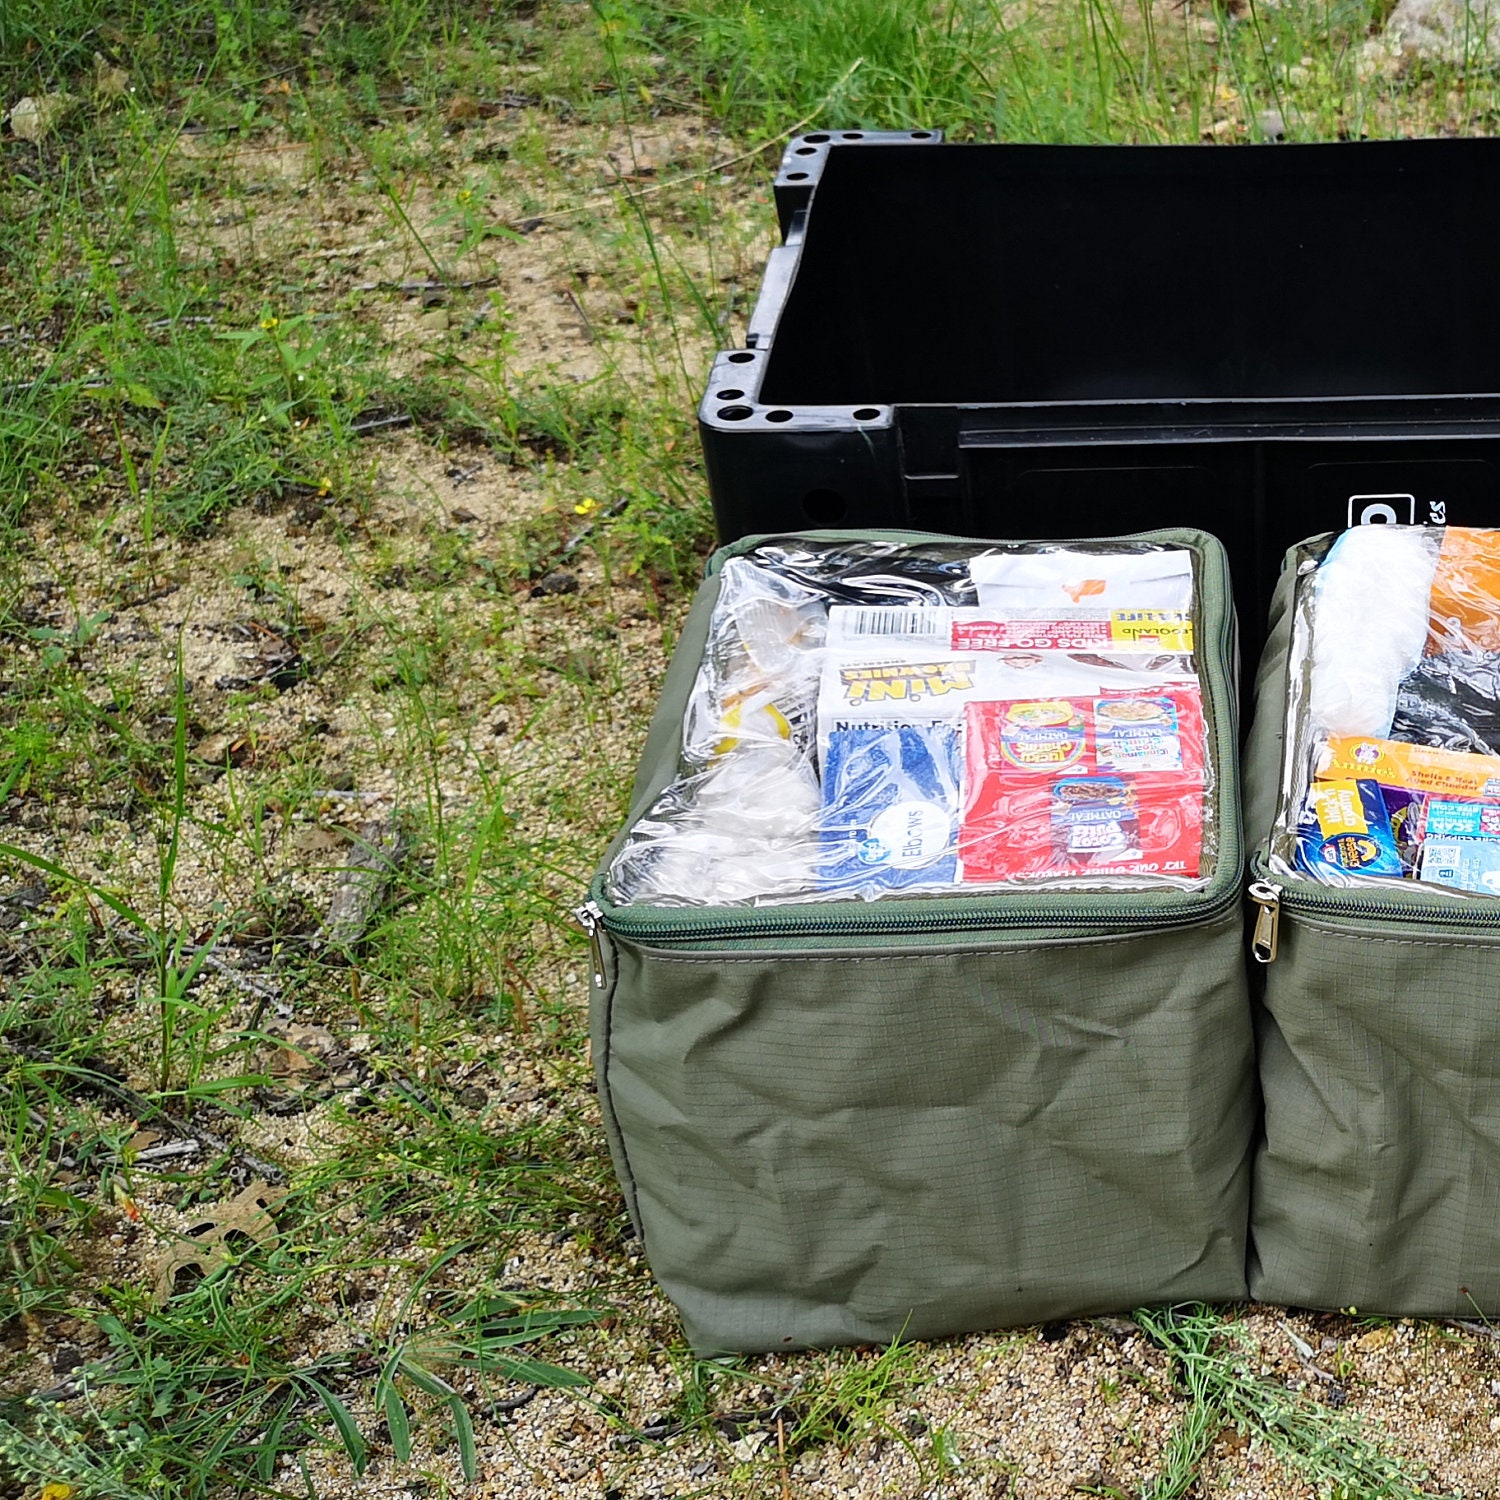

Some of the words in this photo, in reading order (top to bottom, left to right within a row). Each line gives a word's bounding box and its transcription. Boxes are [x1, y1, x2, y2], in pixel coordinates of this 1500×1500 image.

[957, 638, 1010, 650] FREE
[1019, 638, 1053, 649] GO
[1057, 637, 1108, 649] KIDS
[1017, 731, 1068, 741] OATMEAL
[1110, 727, 1162, 738] OATMEAL
[1412, 771, 1443, 781] Shells
[1435, 780, 1478, 791] Cheddar
[1069, 811, 1121, 821] OATMEAL
[1432, 822, 1475, 833] SCAN
[902, 810, 924, 857] Elbows
[1129, 865, 1159, 875] OUR
[1162, 861, 1188, 870] TRY
